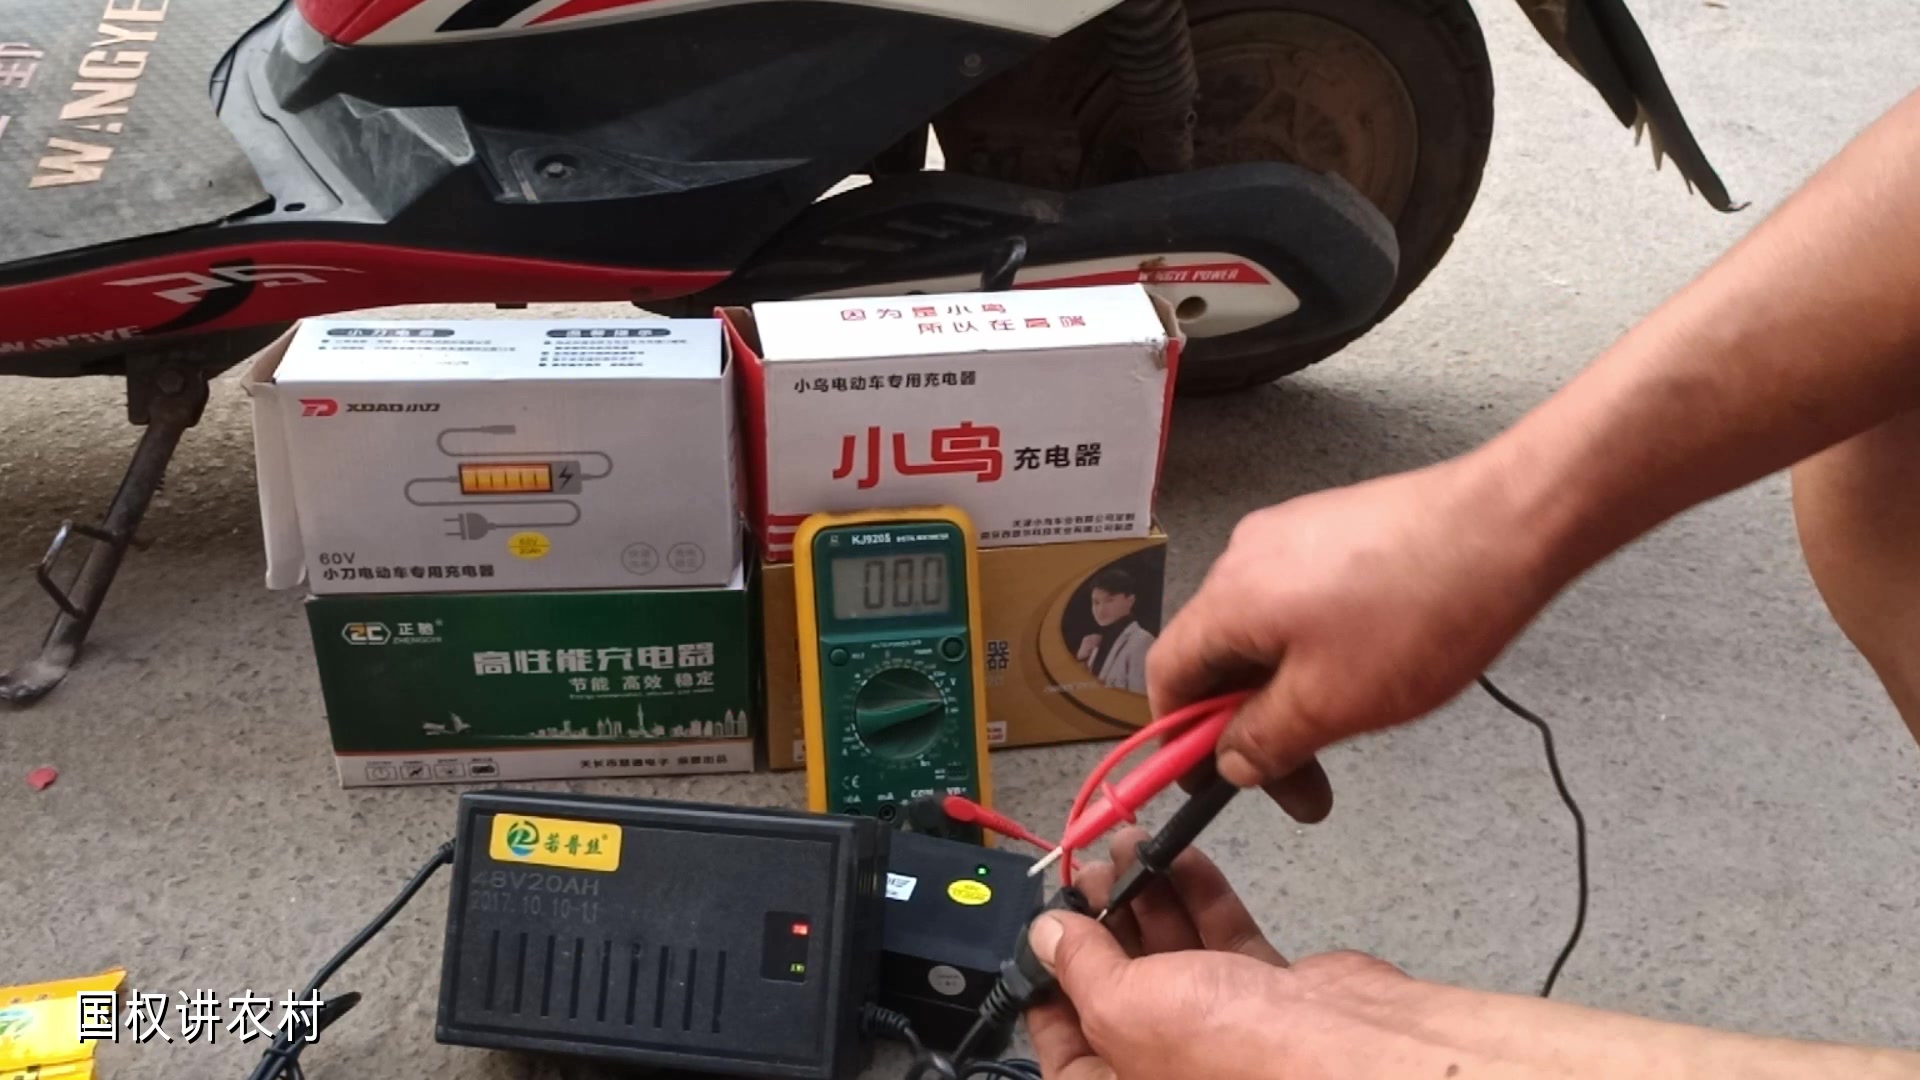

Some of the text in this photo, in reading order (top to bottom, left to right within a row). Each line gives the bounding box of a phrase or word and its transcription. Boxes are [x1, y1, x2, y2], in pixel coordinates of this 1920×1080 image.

[840, 303, 1007, 321] 因为是小鸟
[918, 315, 1086, 335] 所以在高端
[794, 370, 977, 393] 小鸟电动车专用充电器
[832, 421, 1102, 490] 小鸟 充电器
[319, 552, 355, 566] 60V
[322, 565, 495, 581] 小刀电动车专用充电器
[473, 641, 715, 676] 高性能充电器
[568, 676, 611, 693] 节能
[622, 674, 663, 691] 高效
